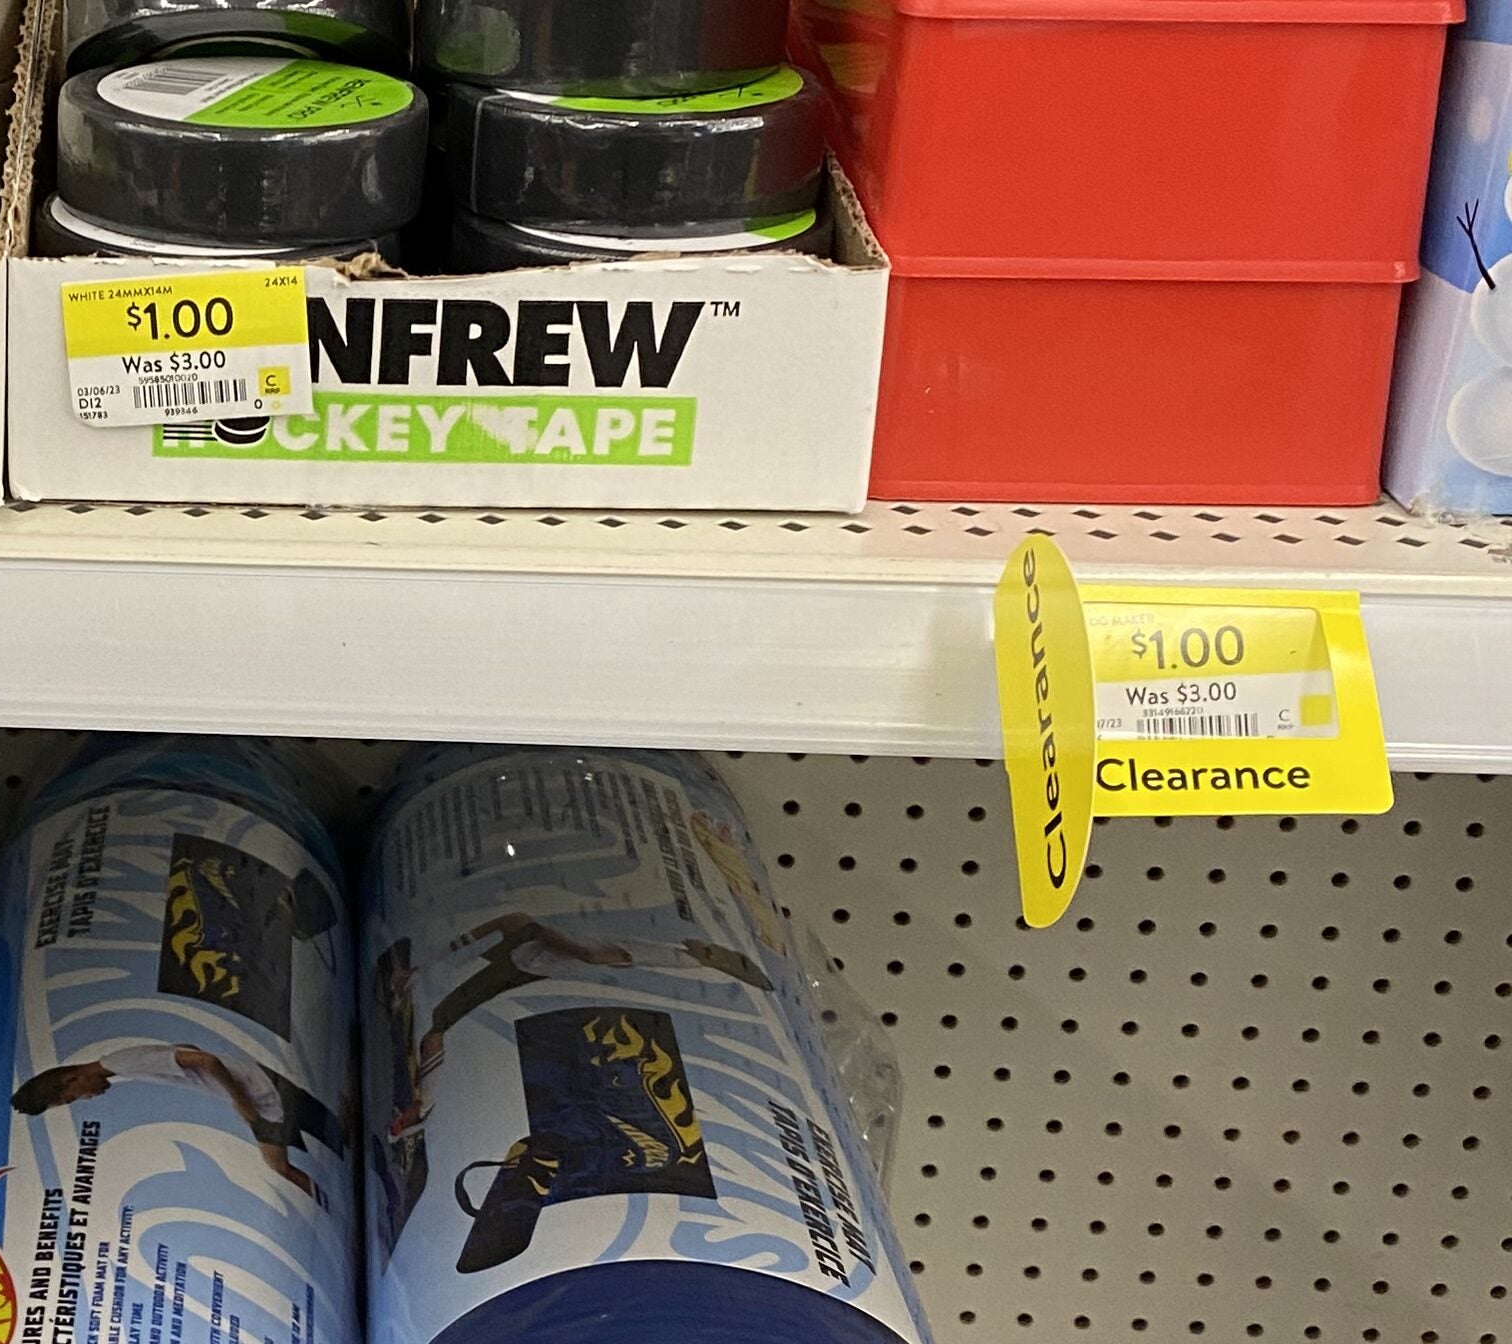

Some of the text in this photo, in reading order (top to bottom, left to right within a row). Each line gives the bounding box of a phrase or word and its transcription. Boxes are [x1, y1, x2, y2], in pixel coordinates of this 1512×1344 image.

[68, 286, 172, 302] WHITE 24MMX14M
[265, 277, 298, 288] 24X14
[126, 297, 234, 340] $1.00
[121, 350, 226, 374] Was $3.00
[77, 386, 121, 397] 03/06/23
[1132, 625, 1245, 671] $1.00
[1126, 681, 1237, 705] Was $3.00
[1022, 549, 1067, 889] Clearance
[1096, 759, 1311, 792] Clearance
[768, 1100, 810, 1164] TAPIS
[73, 1120, 101, 1208] AVANTAGES
[806, 1117, 877, 1276] EXERCISE MAT
[36, 1187, 64, 1263] BENEFITS
[69, 1208, 88, 1230] ET
[29, 1264, 51, 1300] AND
